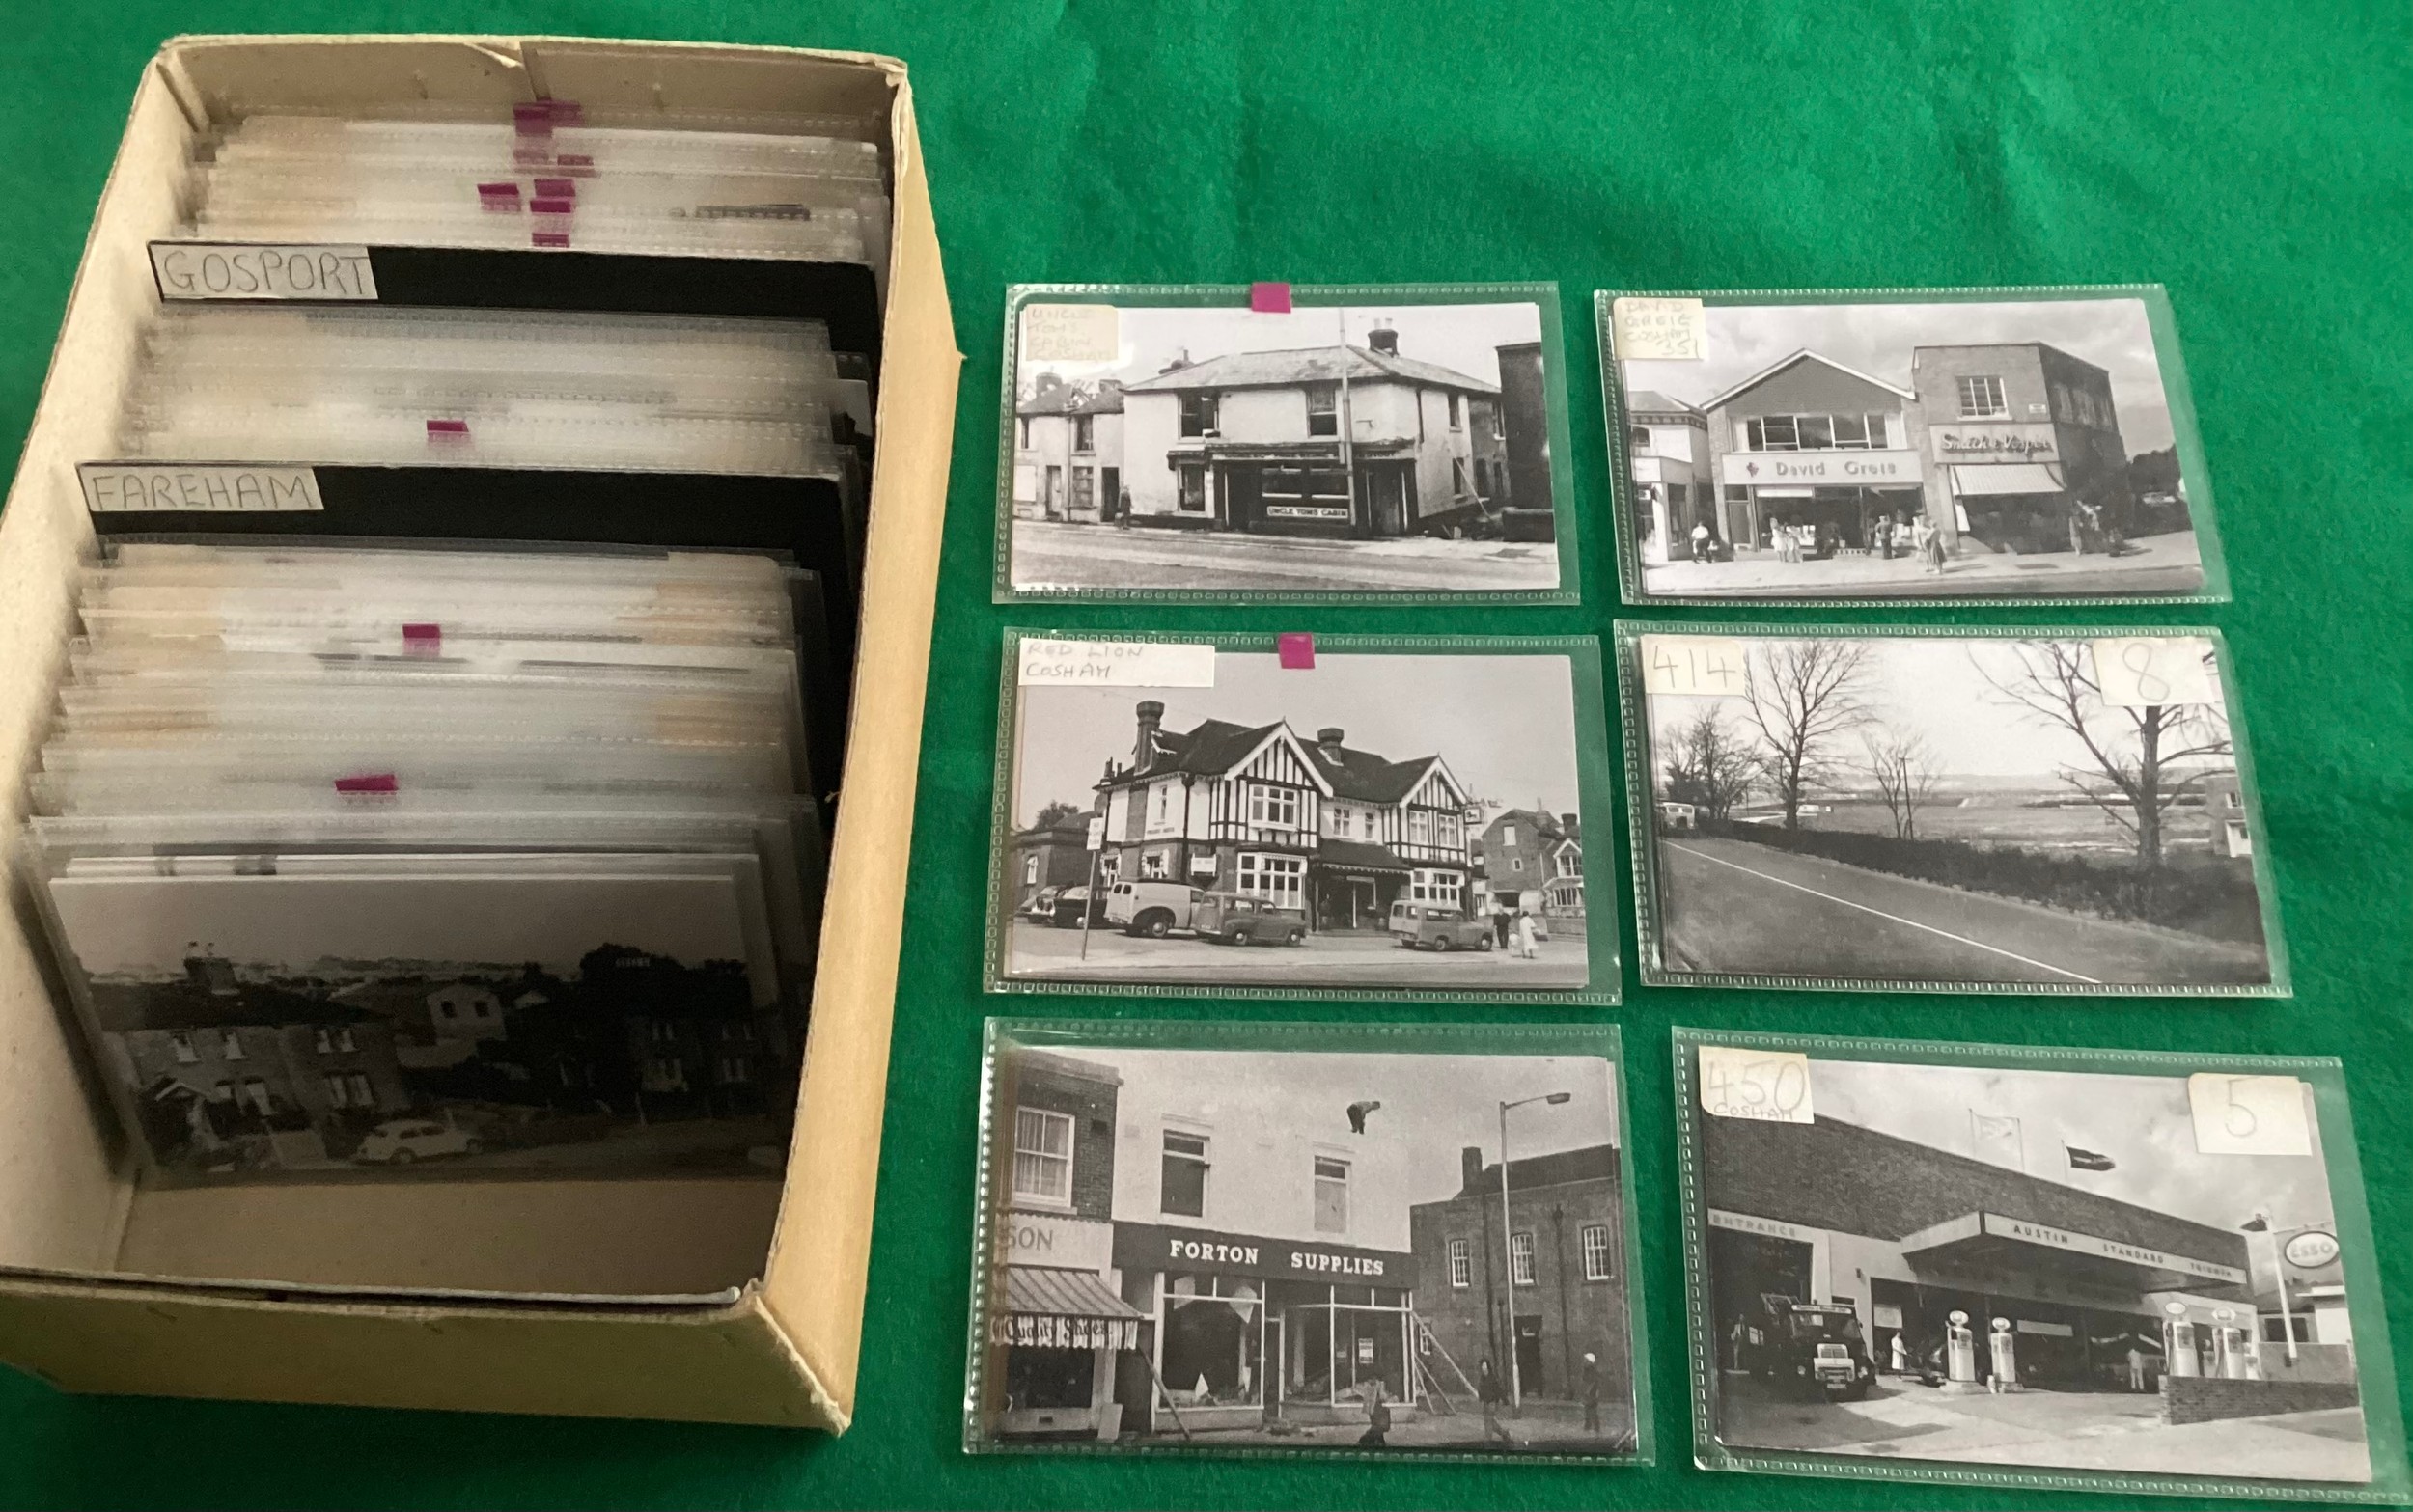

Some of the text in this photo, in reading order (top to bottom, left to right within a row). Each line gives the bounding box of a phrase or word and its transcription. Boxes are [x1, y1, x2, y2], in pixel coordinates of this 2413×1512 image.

[164, 249, 369, 294] GOSPORT
[1625, 300, 1683, 312] DAVID
[1775, 461, 1825, 476] David
[93, 473, 314, 509] FAREHAM
[1028, 644, 1143, 658] RED LION
[1653, 645, 1737, 689] 414
[1026, 662, 1111, 677] COSHAM
[2122, 642, 2171, 702] 8
[1708, 1060, 1806, 1113] 450
[1714, 1102, 1793, 1121] COSHAM
[2225, 1076, 2257, 1138] 5
[1712, 1214, 1796, 1238] ENTRANCE
[2012, 1224, 2069, 1245] AUSTIN
[2103, 1243, 2165, 1264] STANDARD
[1170, 1239, 1384, 1276] FORTON SUPPLIES
